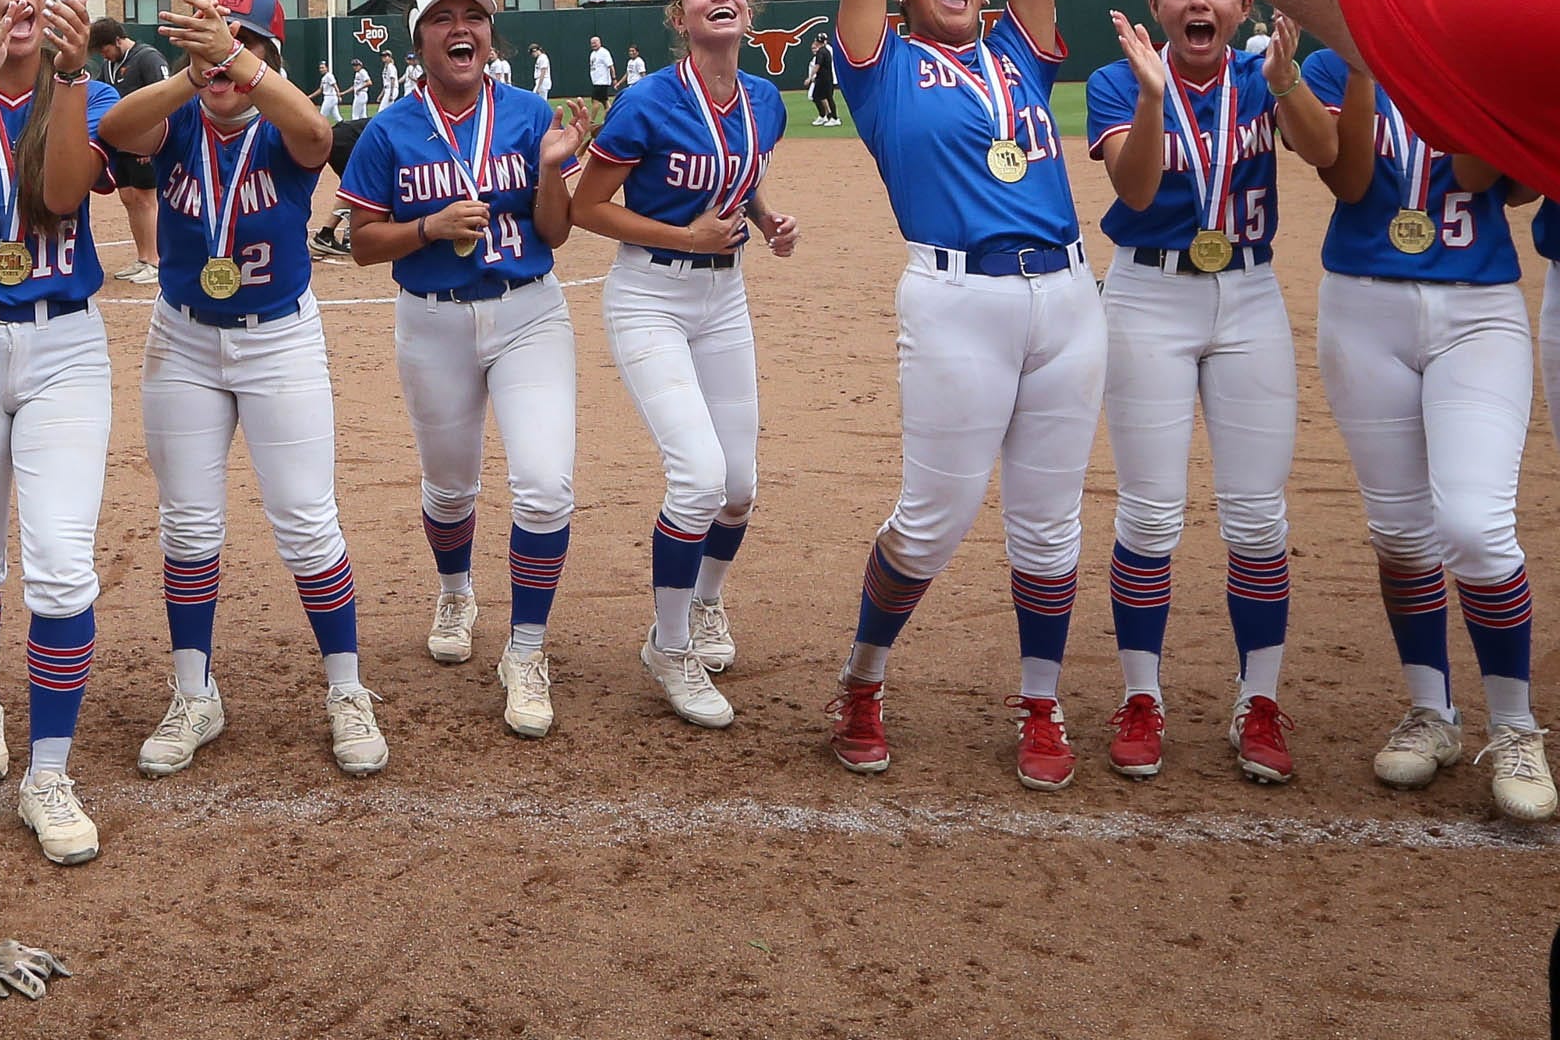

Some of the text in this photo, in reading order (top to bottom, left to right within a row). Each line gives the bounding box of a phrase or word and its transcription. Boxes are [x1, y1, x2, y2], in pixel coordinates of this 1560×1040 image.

[365, 29, 384, 39] 200
[481, 212, 523, 264] 14
[1224, 188, 1267, 244] 15
[1441, 191, 1474, 247] 5
[240, 241, 272, 286] 2
